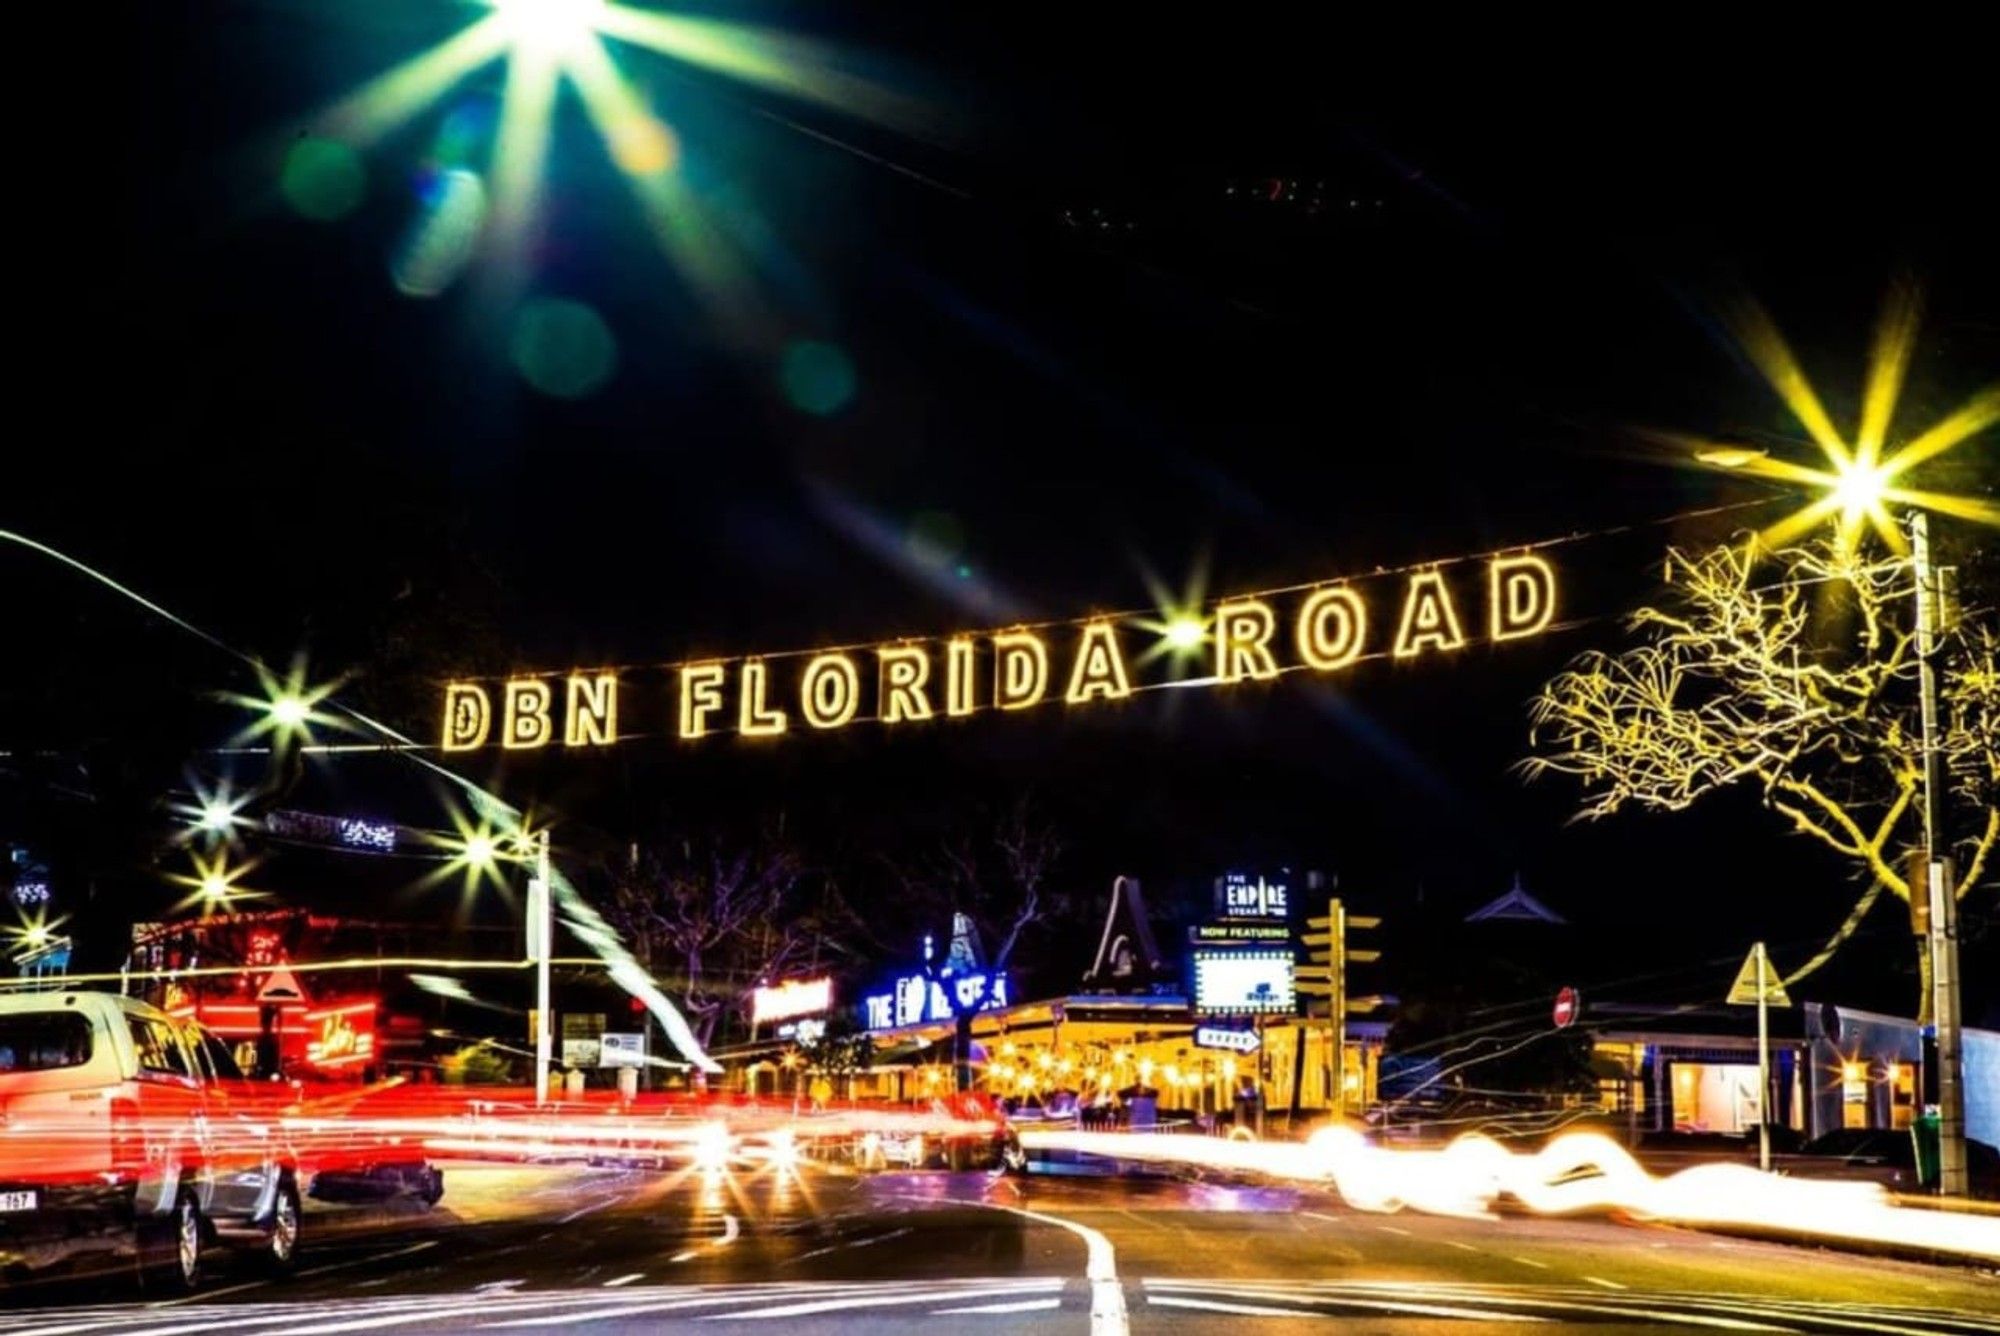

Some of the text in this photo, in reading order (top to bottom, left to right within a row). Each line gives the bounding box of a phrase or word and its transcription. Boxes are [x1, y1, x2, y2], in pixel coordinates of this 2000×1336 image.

[442, 555, 1556, 752] DBN FLORIDA ROAD
[1228, 875, 1245, 883] THE
[1200, 926, 1290, 939] NOW FEATURING
[866, 994, 894, 1029] THE
